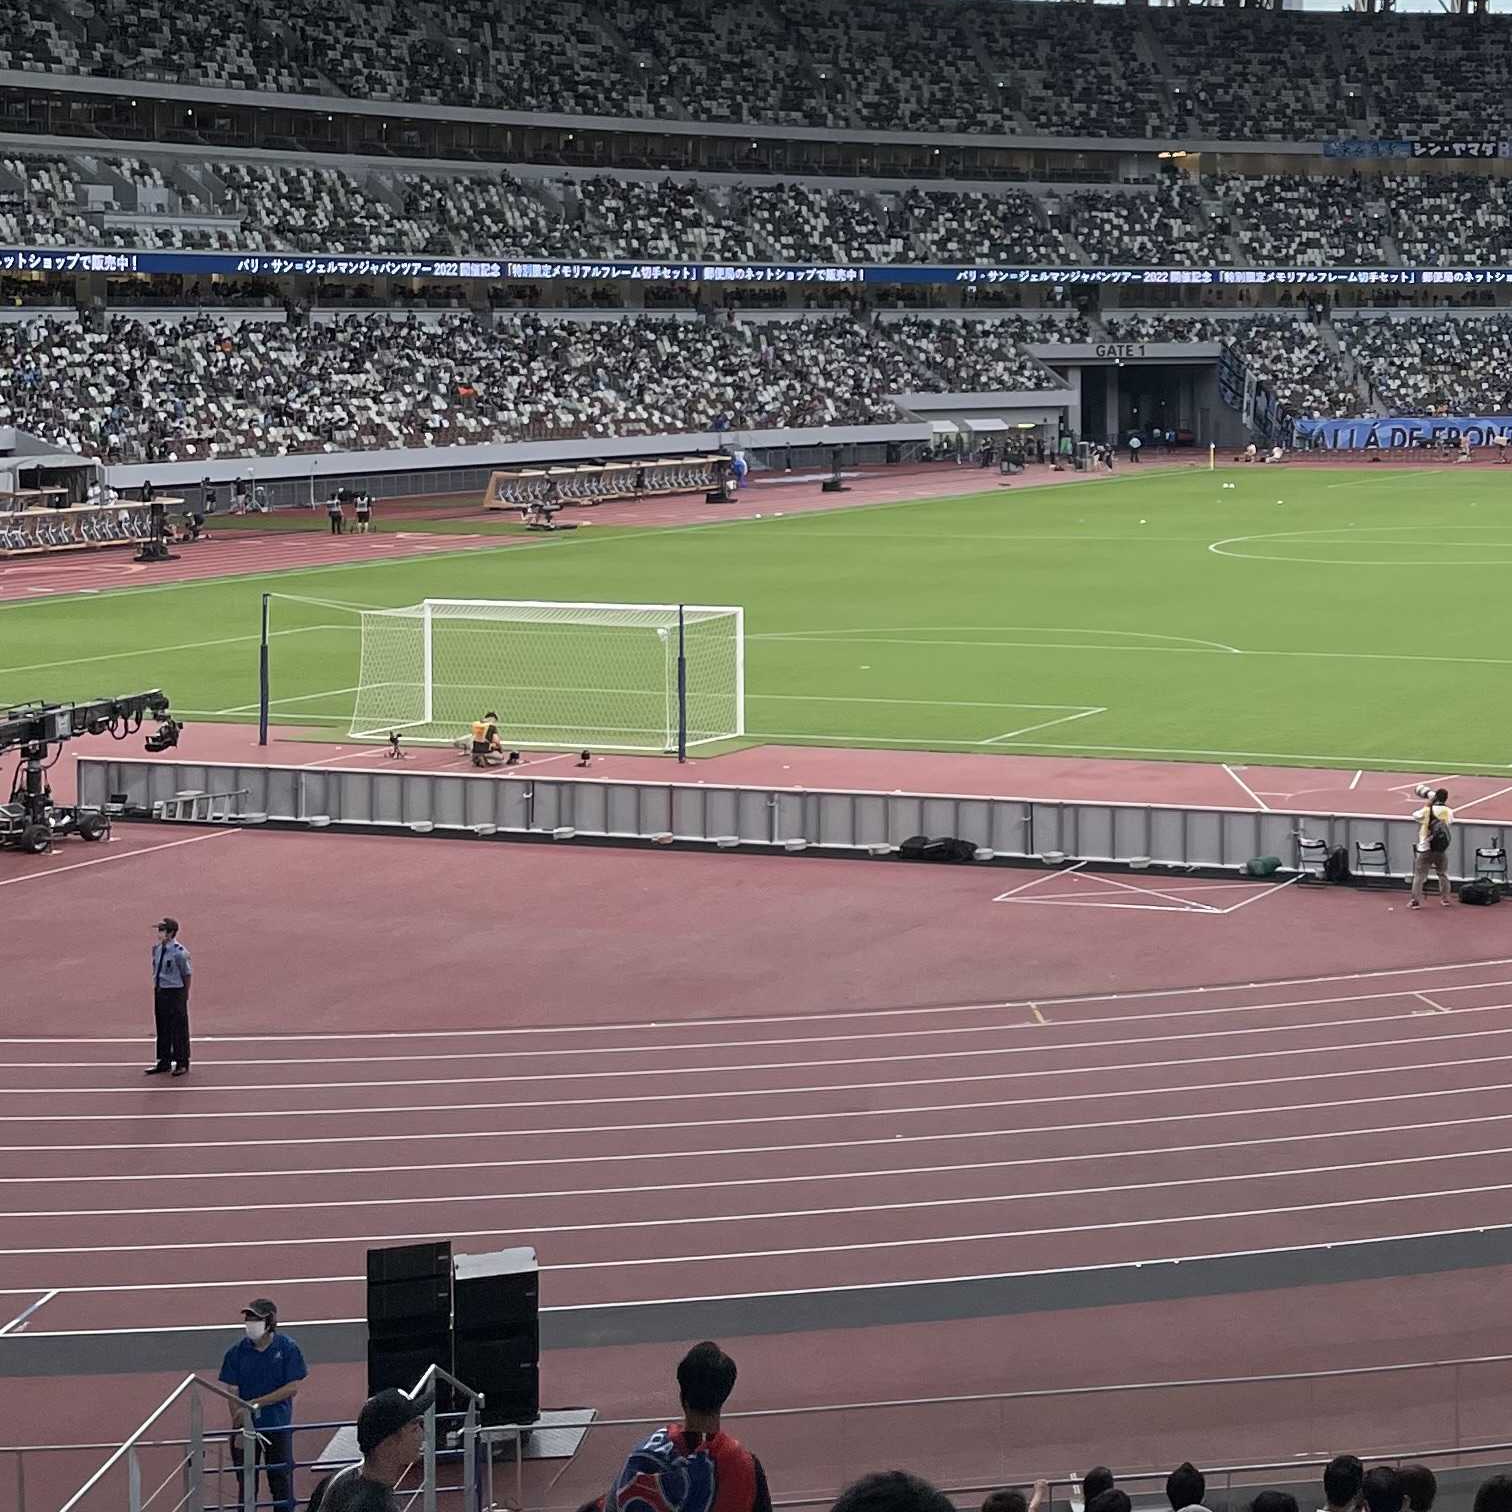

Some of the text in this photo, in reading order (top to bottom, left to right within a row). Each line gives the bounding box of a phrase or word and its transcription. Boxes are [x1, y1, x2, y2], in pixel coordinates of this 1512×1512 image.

[0, 252, 137, 271] ットショップで販売中！
[1096, 344, 1146, 357] GATE 1
